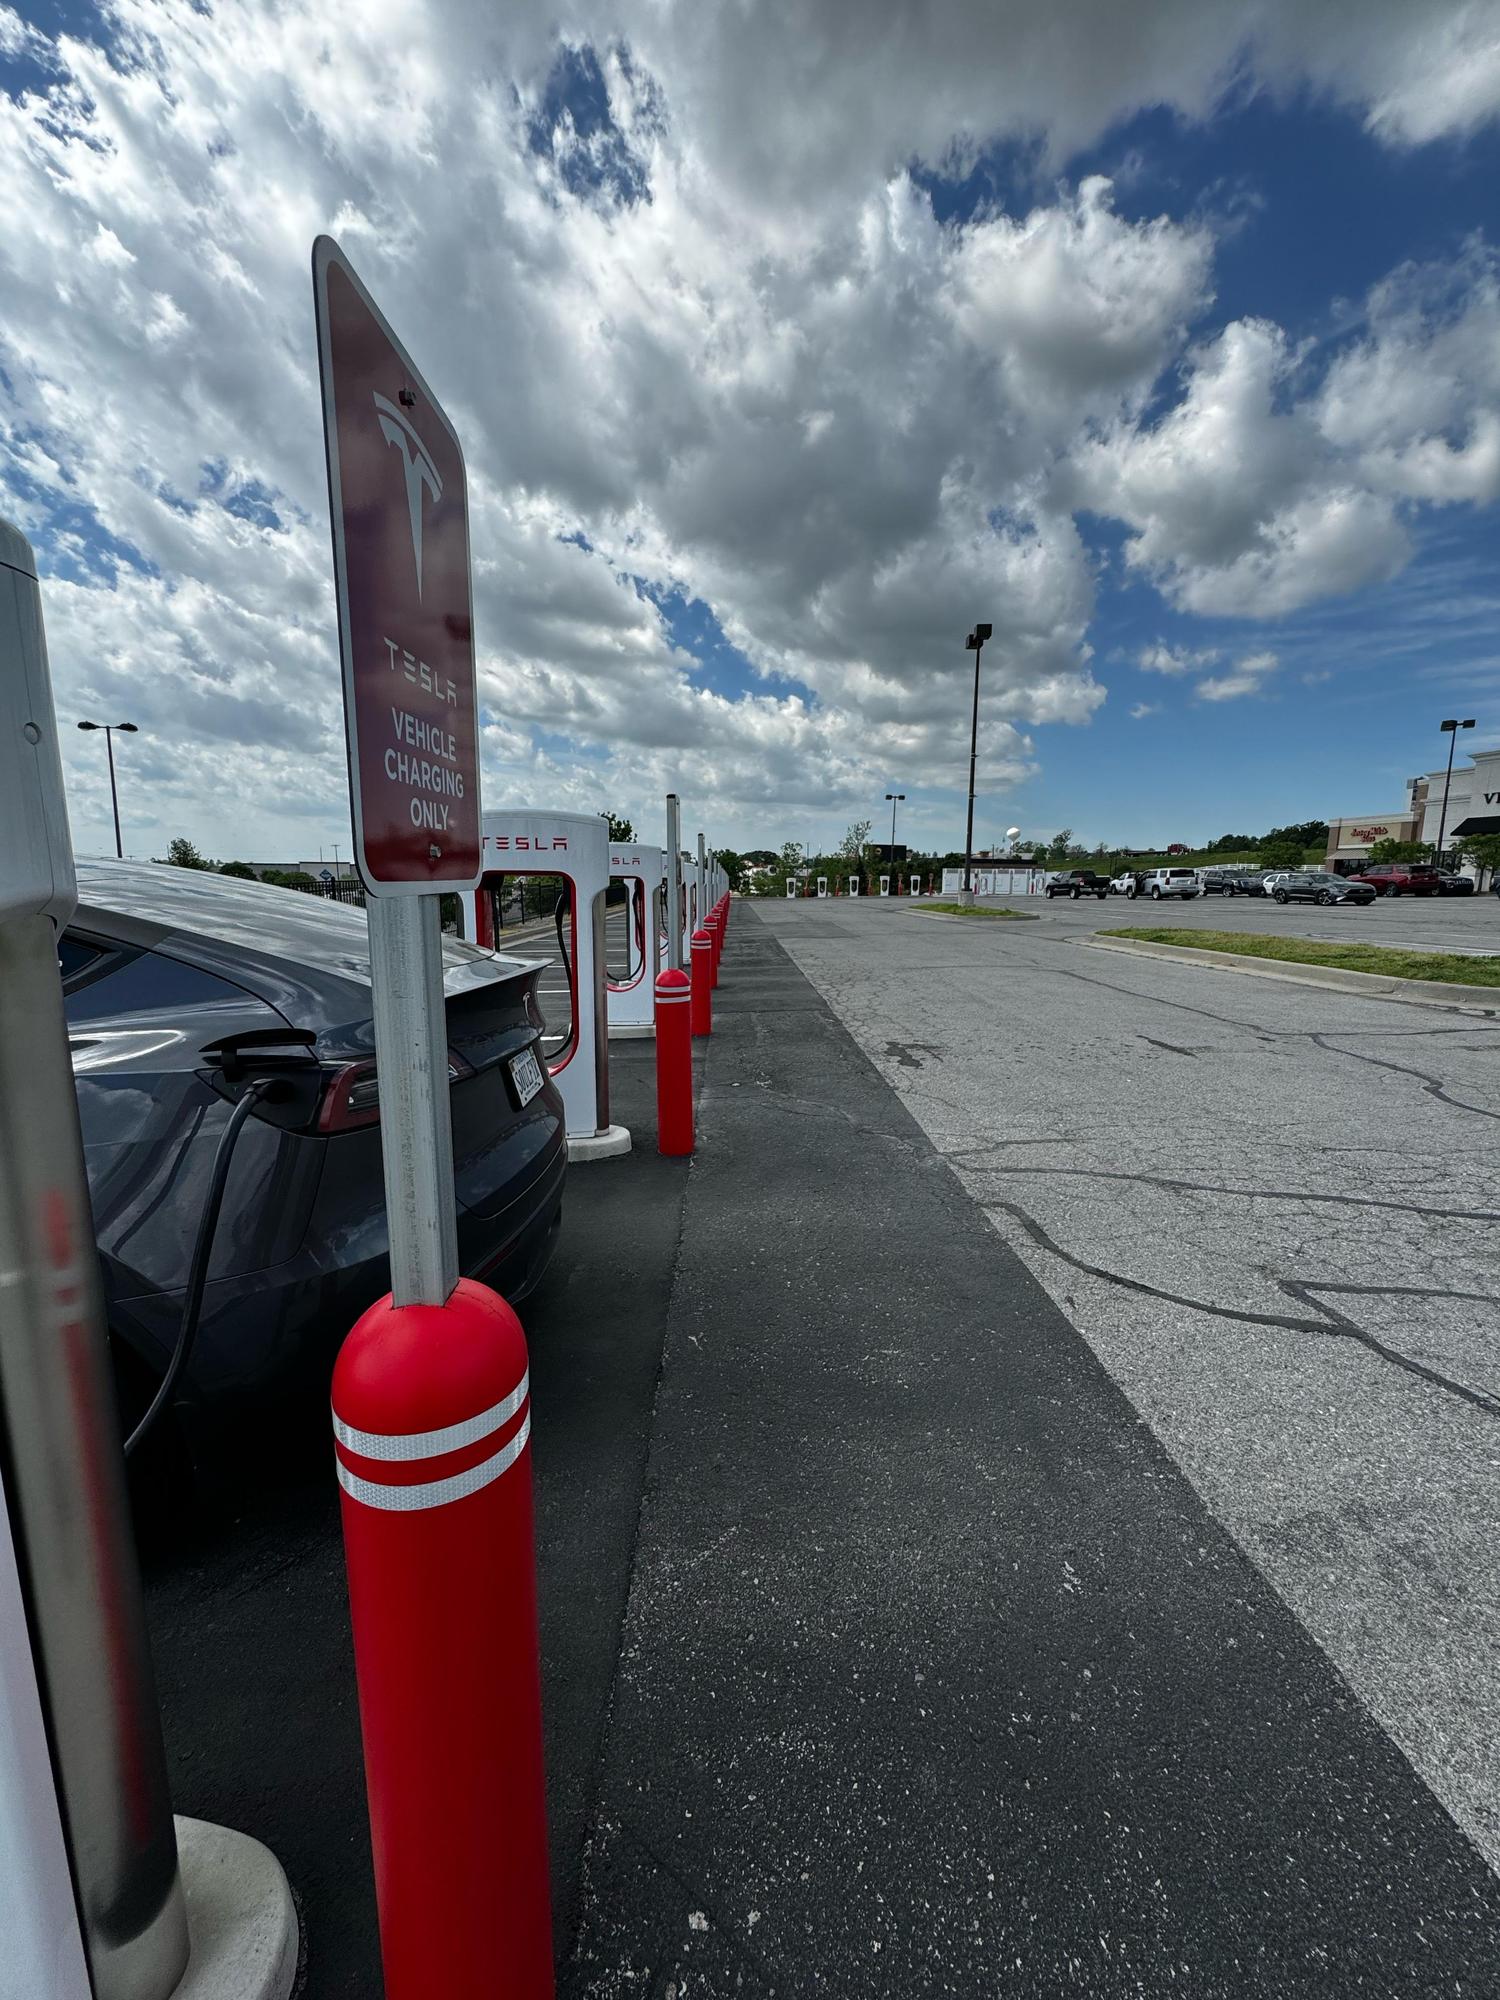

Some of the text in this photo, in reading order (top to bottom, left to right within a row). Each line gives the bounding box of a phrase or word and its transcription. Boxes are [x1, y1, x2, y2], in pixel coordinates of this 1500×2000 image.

[383, 636, 457, 707] TESLA
[391, 706, 457, 762] VEHICLE
[384, 748, 464, 798] CHARGING
[410, 798, 449, 830] ONLY
[611, 857, 641, 865] SLA
